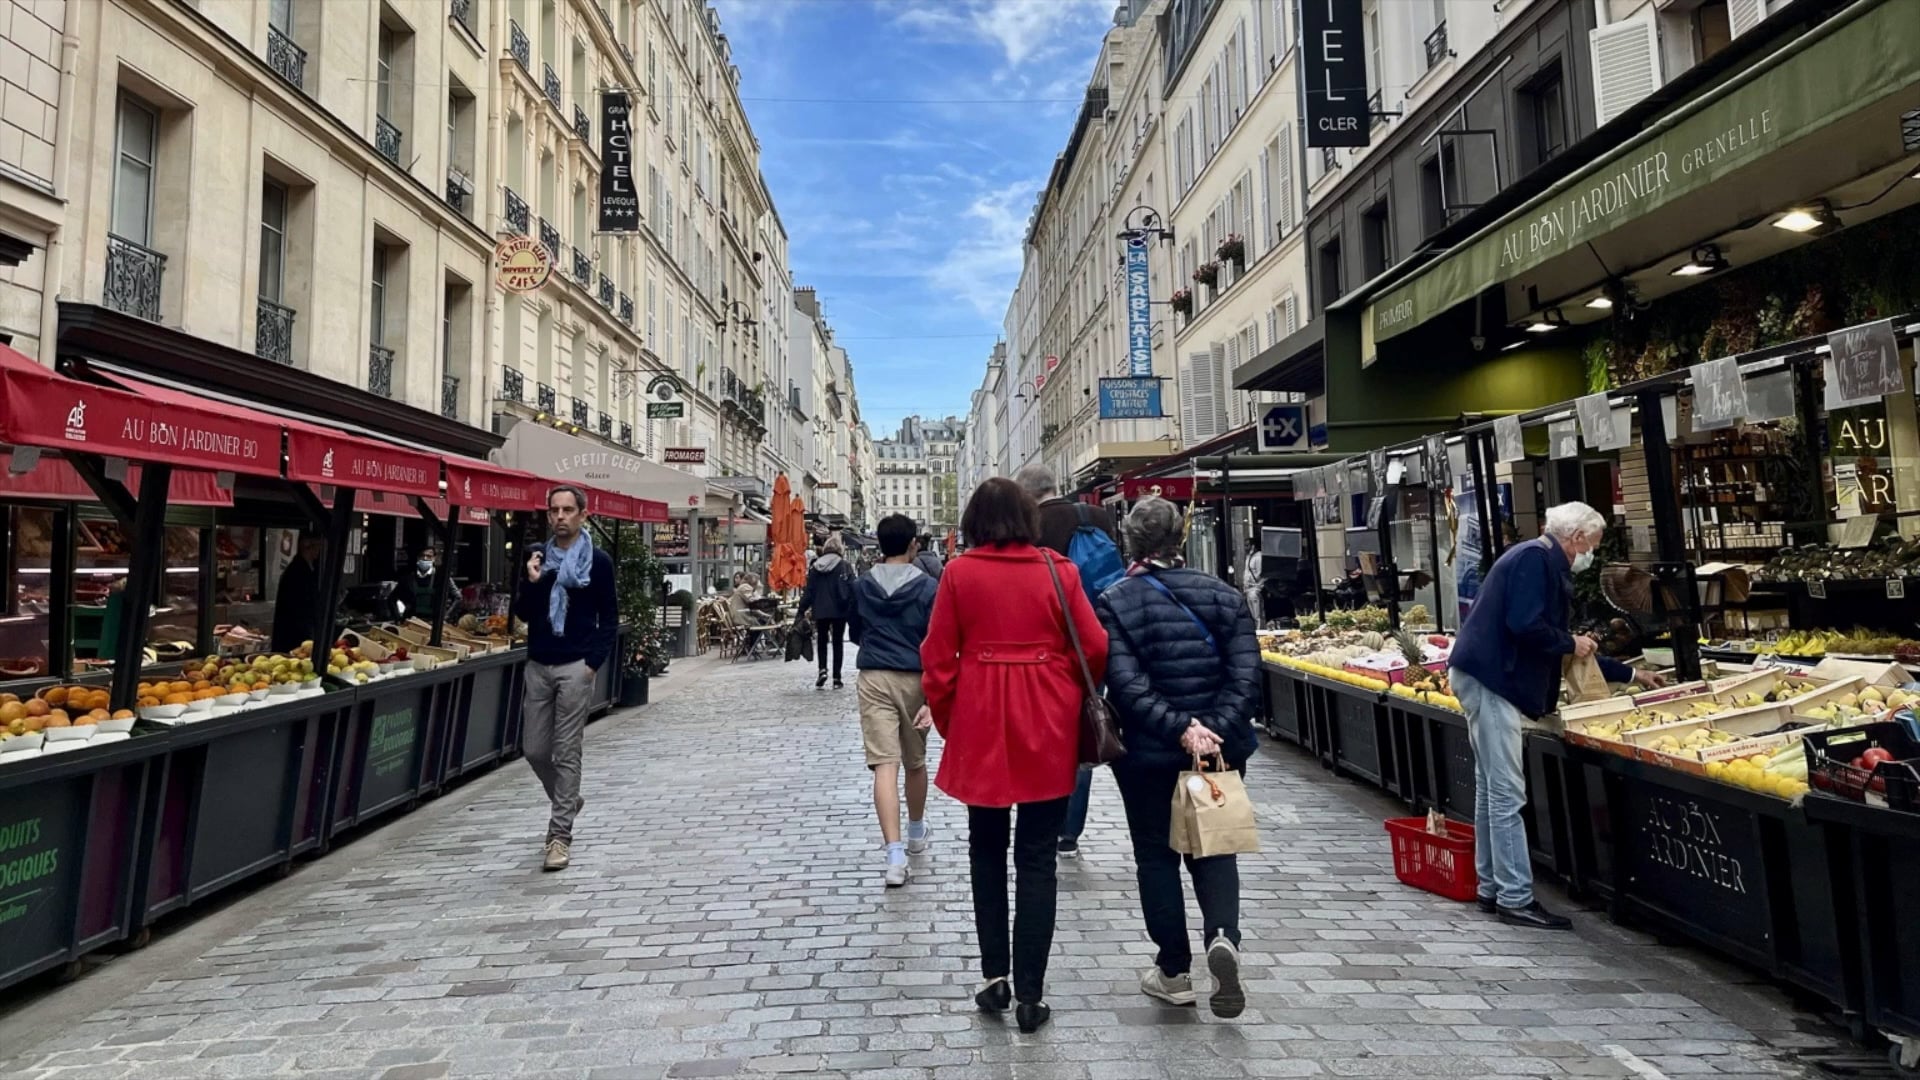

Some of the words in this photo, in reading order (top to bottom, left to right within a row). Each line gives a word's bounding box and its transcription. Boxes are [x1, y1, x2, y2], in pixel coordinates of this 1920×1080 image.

[608, 106, 625, 114] GRA
[1319, 117, 1357, 130] CLER
[1500, 230, 1523, 267] AU
[1570, 152, 1671, 237] JARDINIER
[1681, 110, 1772, 175] GRENELLE
[501, 252, 511, 262] LE
[510, 240, 531, 253] PETIT
[1128, 252, 1147, 262] LA
[1130, 272, 1149, 375] SABLAISE
[1379, 299, 1413, 330] PRIMEUR
[1101, 380, 1137, 389] POISSONS
[67, 406, 84, 428] AB
[122, 418, 144, 440] AU
[182, 428, 240, 456] JARDINIER
[243, 440, 259, 459] BIO
[1836, 419, 1885, 449] AU
[554, 458, 571, 473] LE
[574, 452, 608, 467] PETIT
[611, 455, 641, 473] CLER
[665, 451, 705, 461] FROMAGER
[352, 459, 364, 475] AU
[384, 465, 417, 483] JARDINIER
[1831, 474, 1896, 511] JAR
[1642, 828, 1746, 894] ARDINIER
